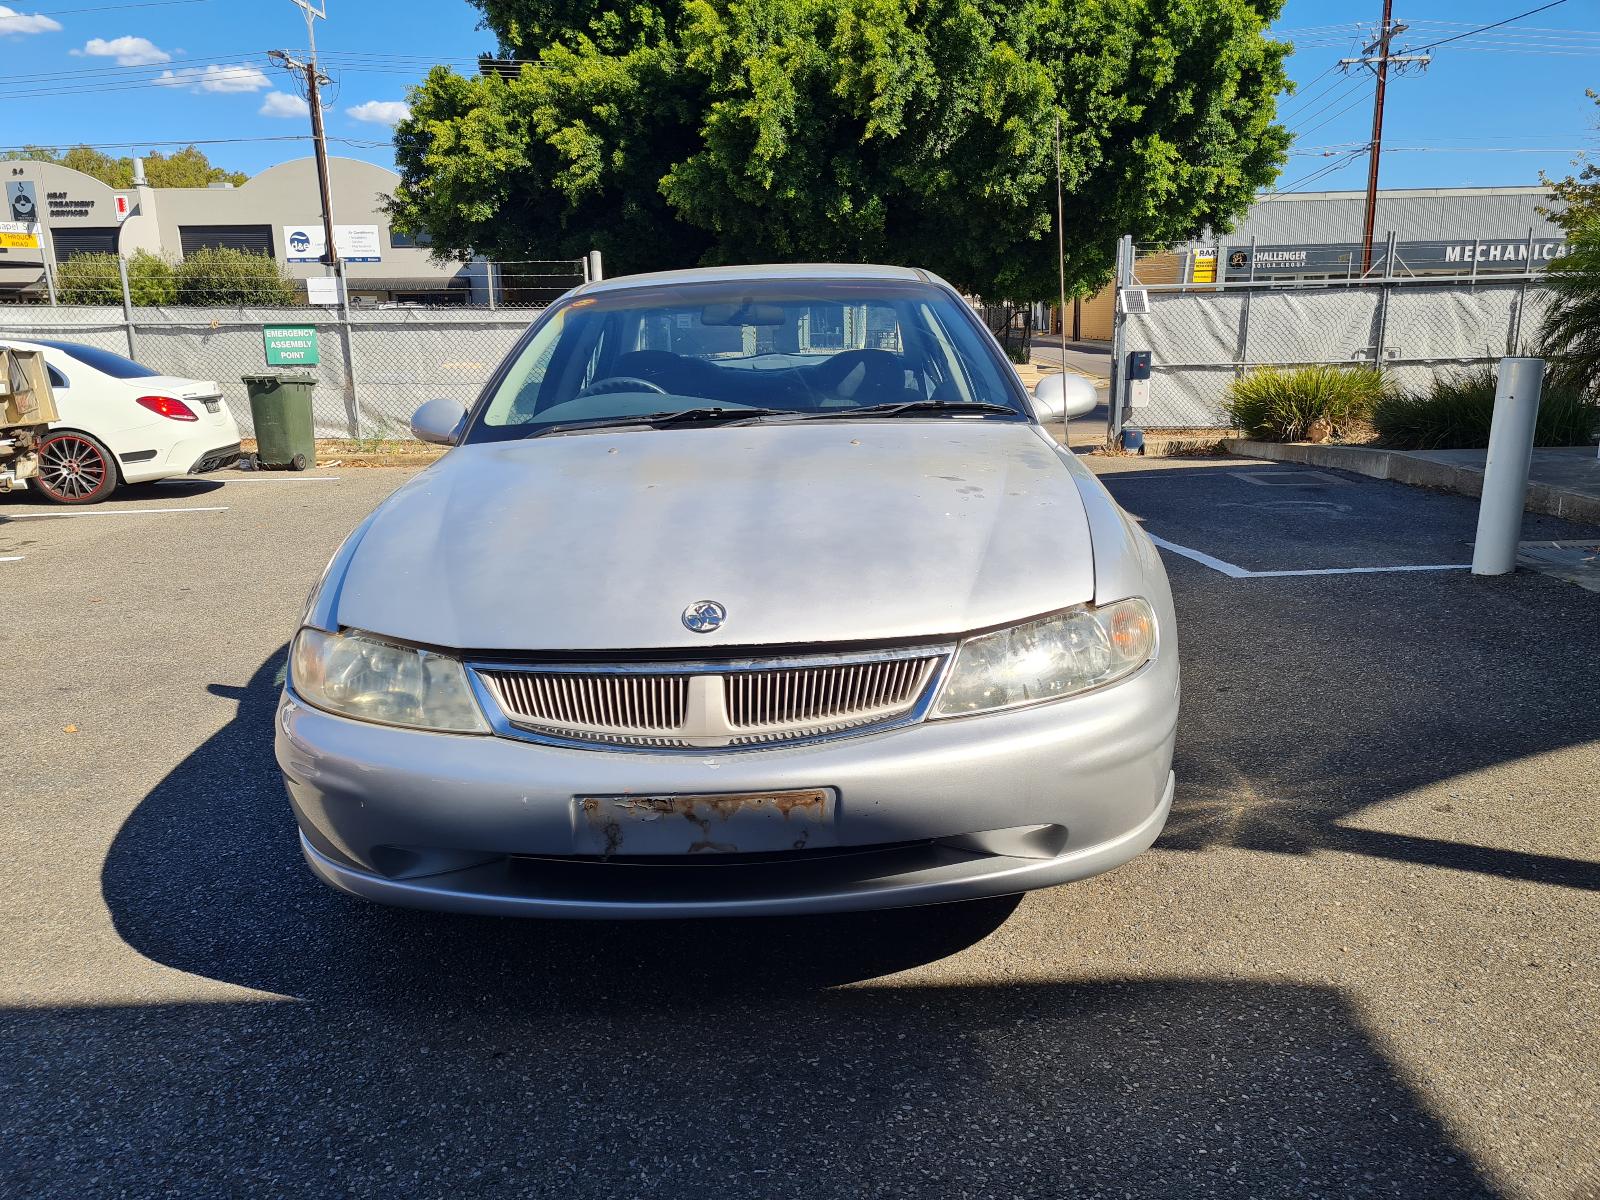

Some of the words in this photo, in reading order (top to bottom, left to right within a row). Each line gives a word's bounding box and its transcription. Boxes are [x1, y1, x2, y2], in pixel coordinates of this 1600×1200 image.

[47, 192, 68, 200] HEAT
[0, 222, 18, 232] apel
[292, 241, 310, 250] d&e
